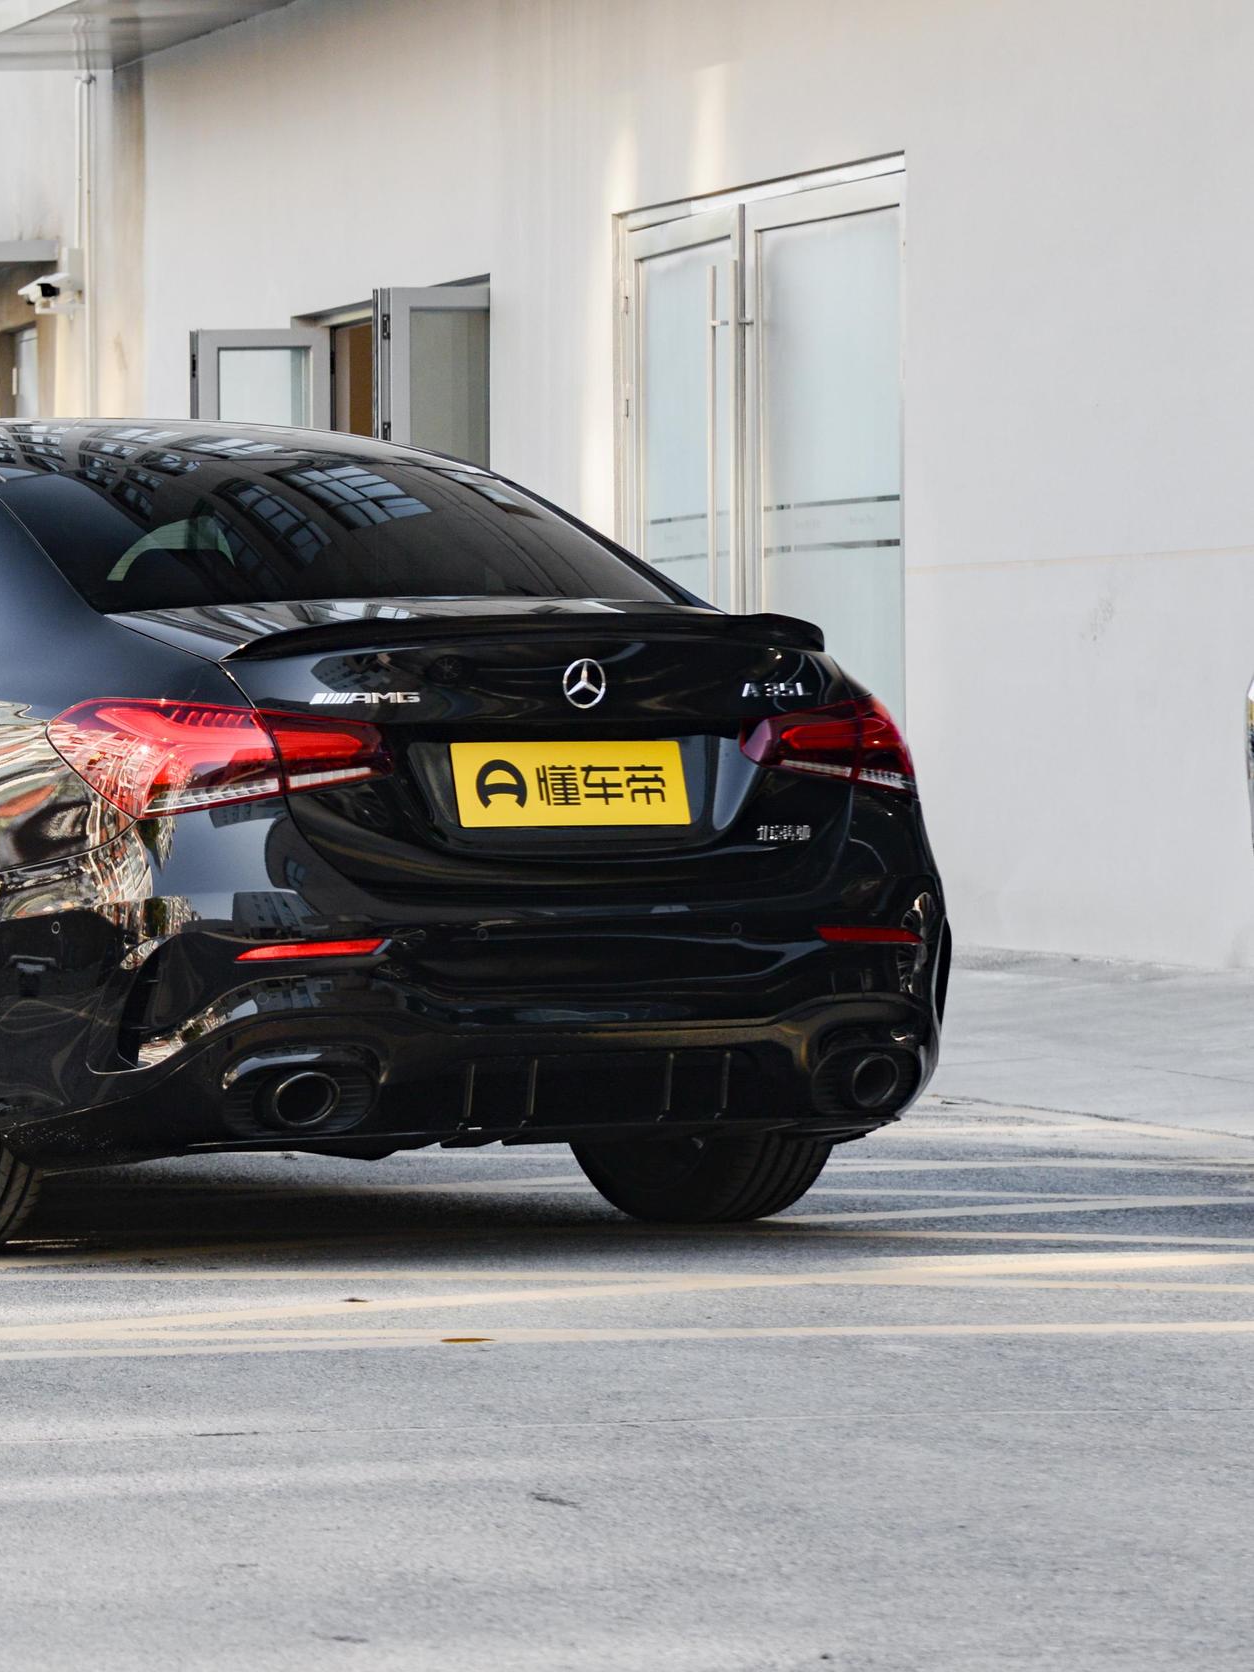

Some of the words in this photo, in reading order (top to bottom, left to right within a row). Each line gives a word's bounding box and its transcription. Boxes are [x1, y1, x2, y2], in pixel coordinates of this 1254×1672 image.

[346, 692, 421, 704] AMG
[535, 764, 666, 806] 懂车帝
